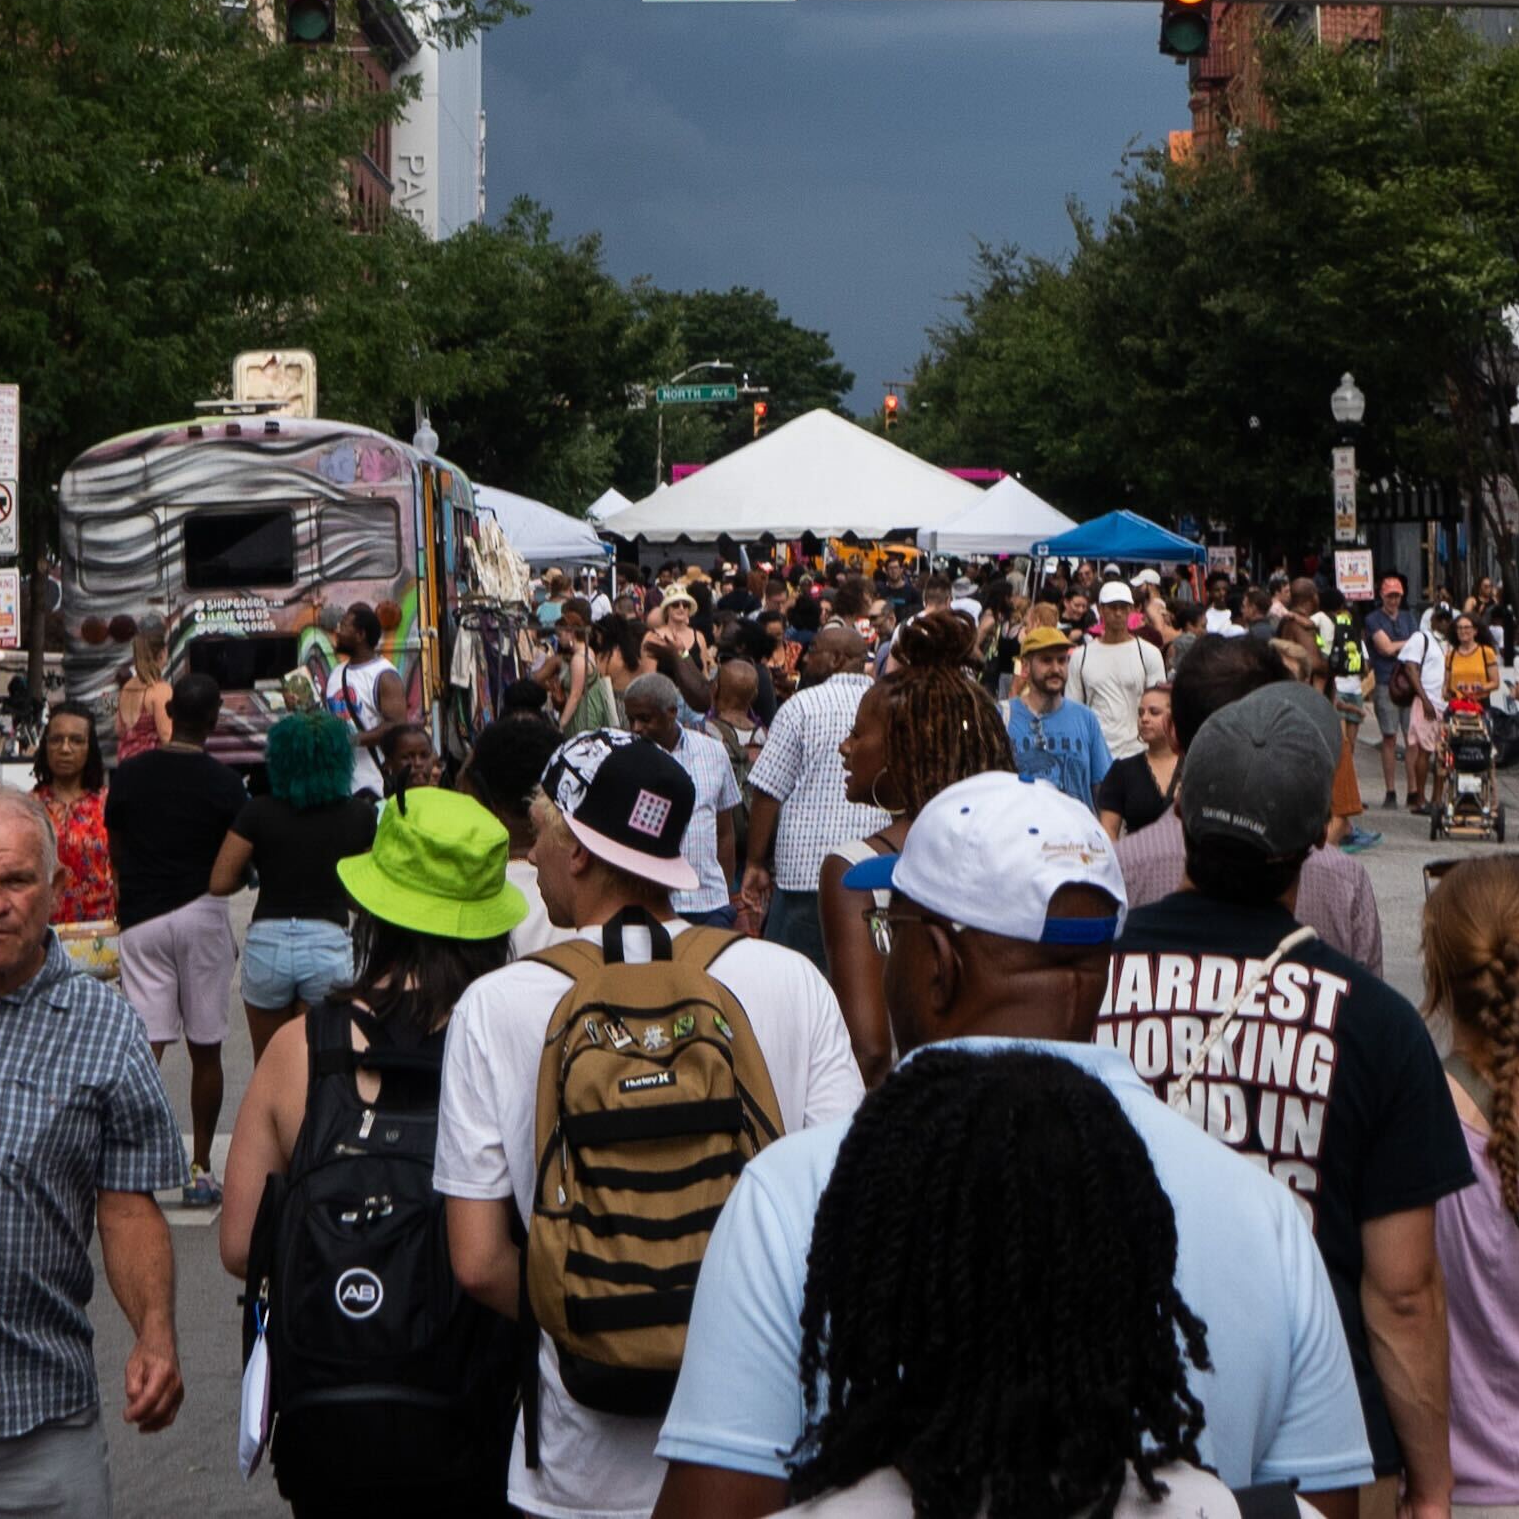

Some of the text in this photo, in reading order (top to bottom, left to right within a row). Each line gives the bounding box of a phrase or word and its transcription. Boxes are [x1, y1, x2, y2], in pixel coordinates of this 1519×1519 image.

[663, 389, 730, 400] NORTH AVE
[1098, 954, 1348, 1030] ARDEST
[625, 1076, 658, 1088] Hurley
[1258, 1089, 1326, 1159] IN
[342, 1284, 375, 1302] AB
